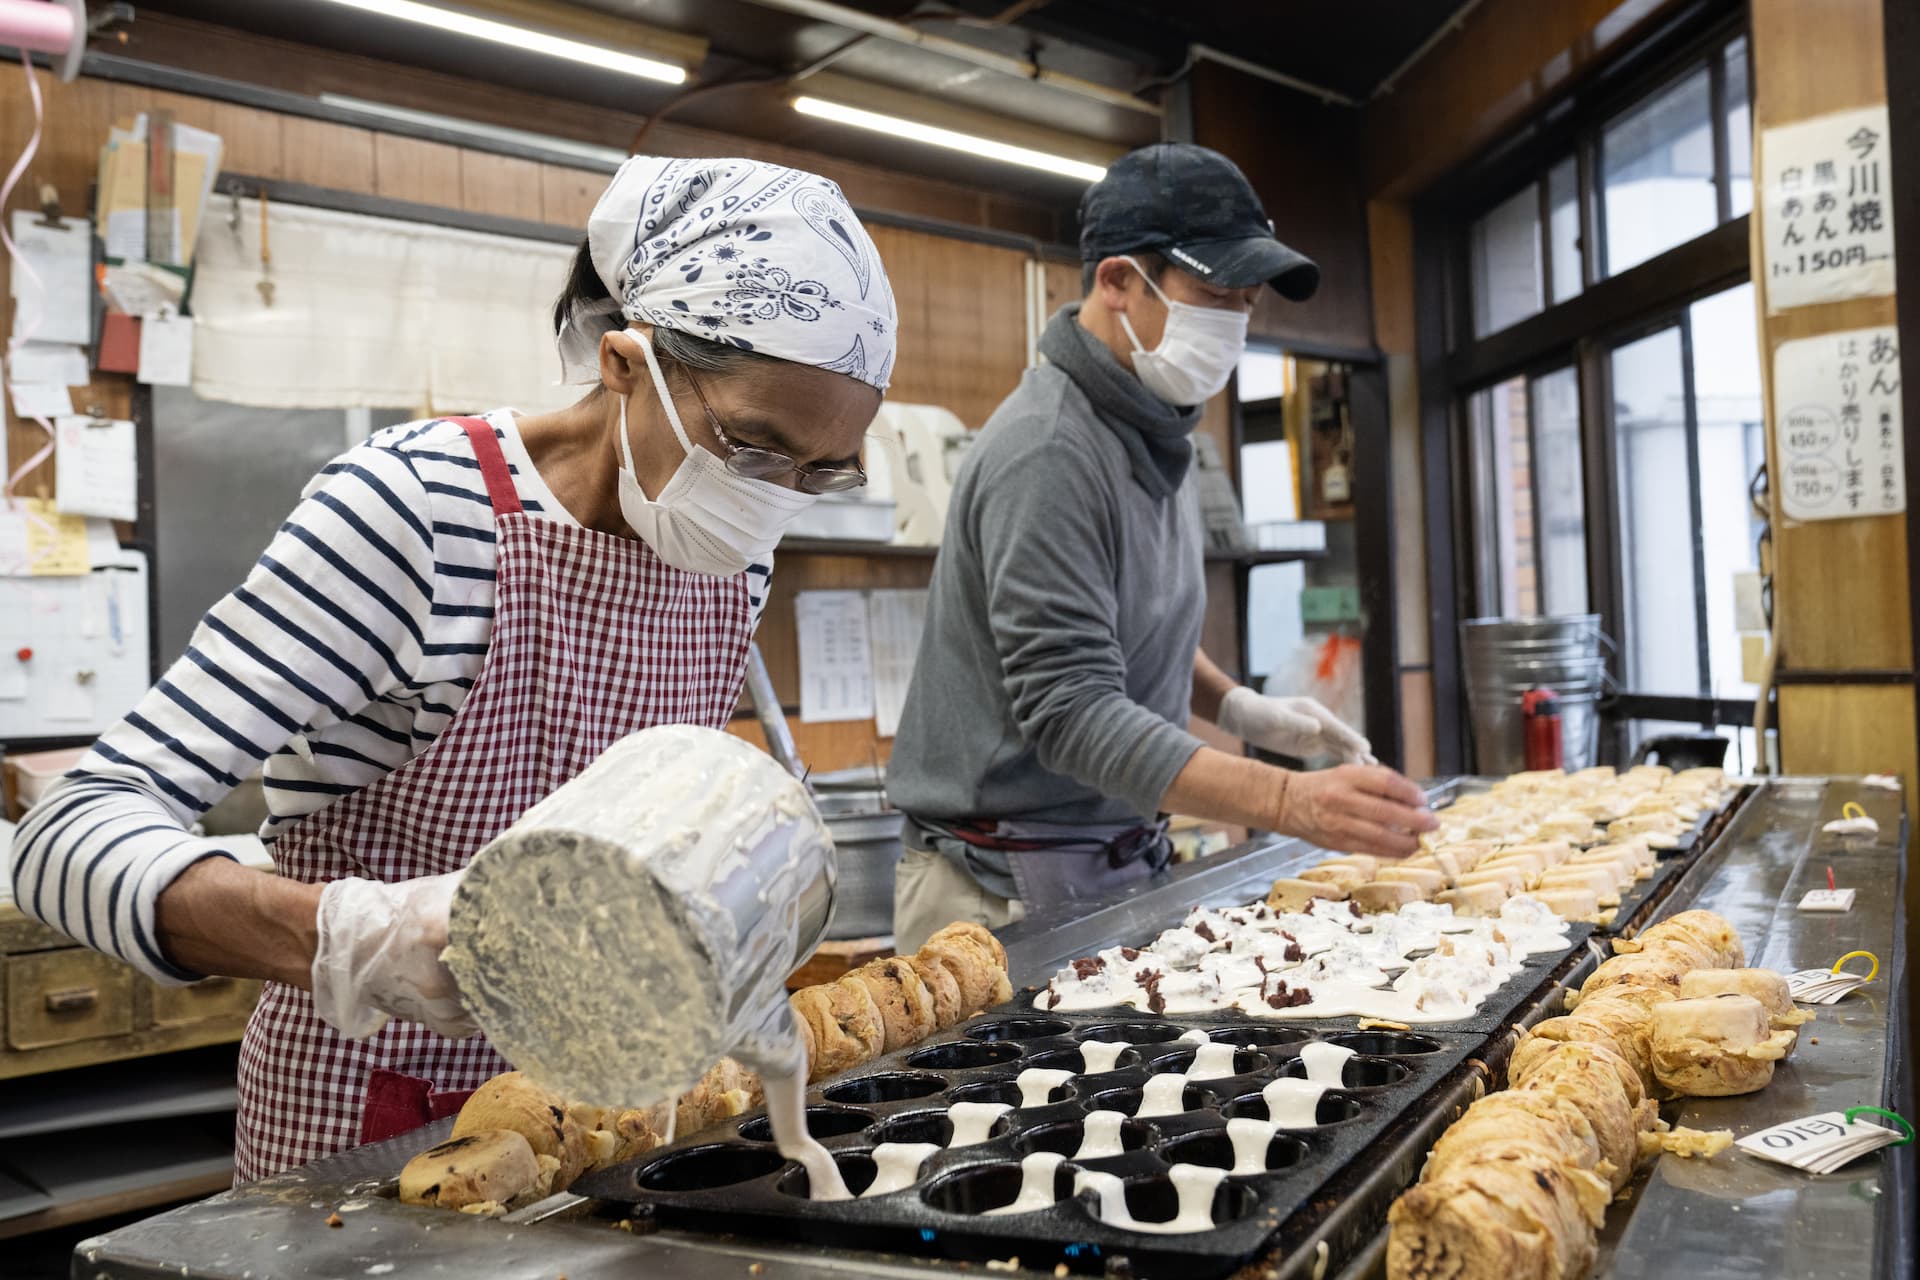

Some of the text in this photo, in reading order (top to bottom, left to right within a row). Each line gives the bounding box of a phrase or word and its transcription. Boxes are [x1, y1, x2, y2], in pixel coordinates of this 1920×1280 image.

[1781, 168, 1804, 246] 白あん
[1813, 160, 1837, 241] 黒あん
[1846, 127, 1882, 234] 今川焼
